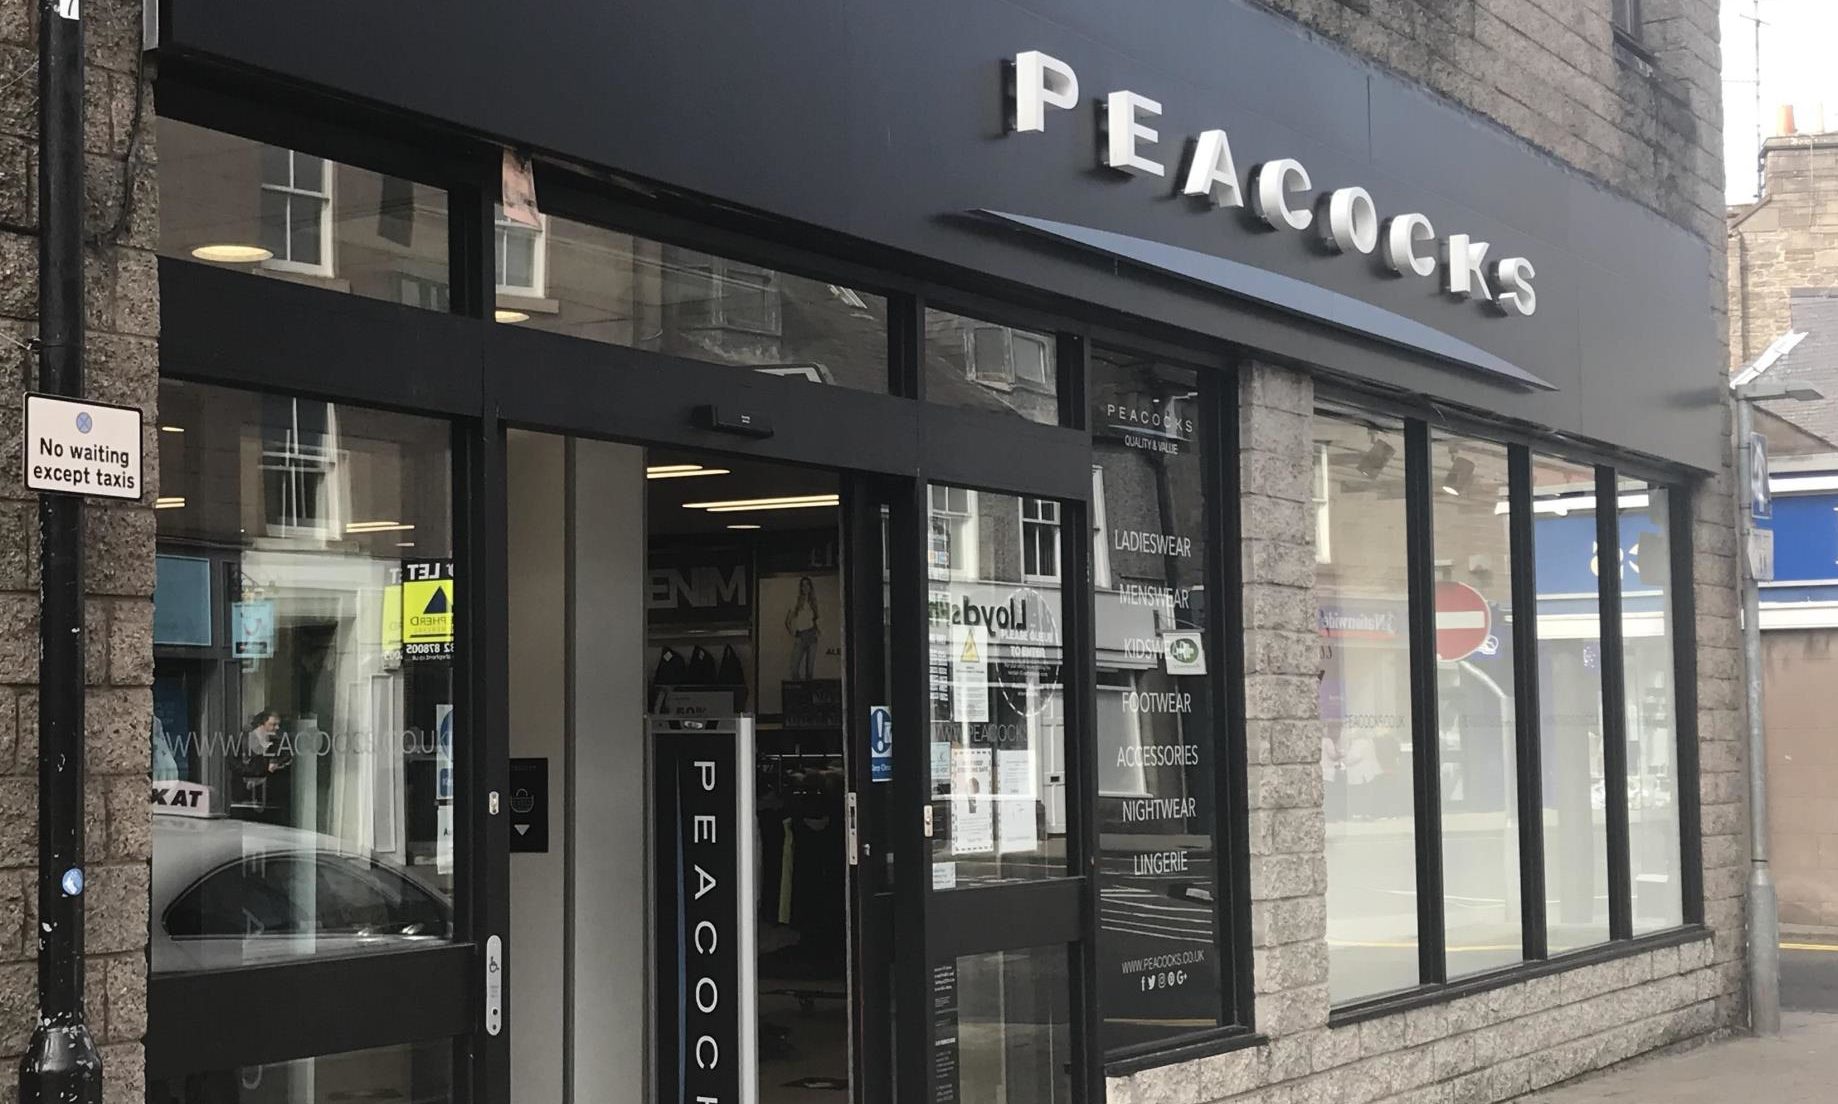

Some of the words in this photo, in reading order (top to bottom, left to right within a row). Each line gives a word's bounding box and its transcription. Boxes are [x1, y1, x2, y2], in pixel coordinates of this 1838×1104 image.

[1016, 50, 1536, 316] PEACOCKS
[1107, 404, 1193, 432] PEACOCKS
[40, 437, 64, 457] No
[70, 444, 129, 468] waiting
[1125, 435, 1152, 450] QUALITY
[1158, 441, 1179, 455] VALUE
[34, 465, 90, 486] except
[96, 468, 135, 489] taxis
[1115, 529, 1191, 558] LADIESWEAR
[1120, 584, 1189, 608] MENSWEAR
[1122, 692, 1192, 713] FOOTWEAR
[1117, 745, 1198, 767] ACCESSORIES
[1122, 798, 1197, 822] NIGHTWEAR
[1134, 851, 1188, 876] LINGERIE
[694, 761, 719, 1104] PEACOC
[1121, 950, 1205, 974] WWW.PEACOCKS.CO.UK
